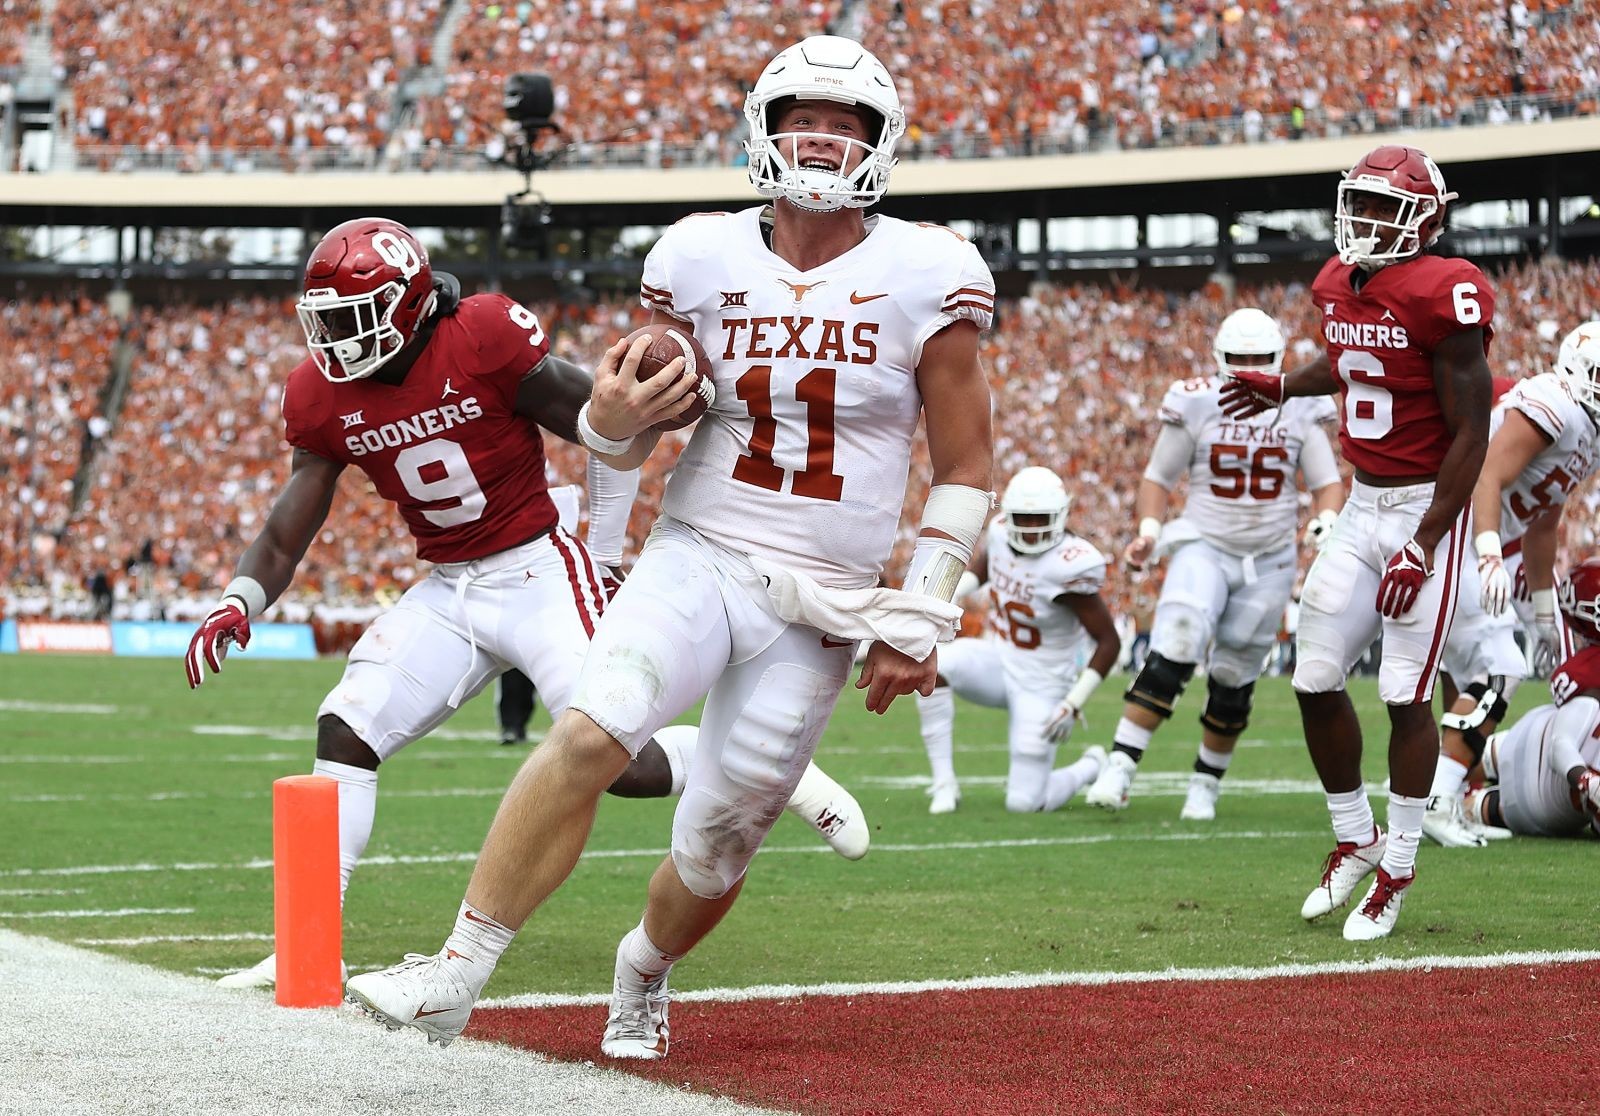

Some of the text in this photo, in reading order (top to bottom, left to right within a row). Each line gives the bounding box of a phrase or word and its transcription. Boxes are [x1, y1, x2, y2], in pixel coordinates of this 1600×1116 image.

[372, 231, 421, 281] OU
[508, 304, 545, 347] 9
[1452, 282, 1482, 324] 6
[722, 316, 879, 364] TEXAS
[1338, 350, 1393, 439] 6
[345, 397, 483, 457] SOONERS
[732, 365, 844, 501] 11
[1219, 423, 1288, 443] TEXAS
[394, 438, 488, 528] 9
[1210, 444, 1288, 499] 56
